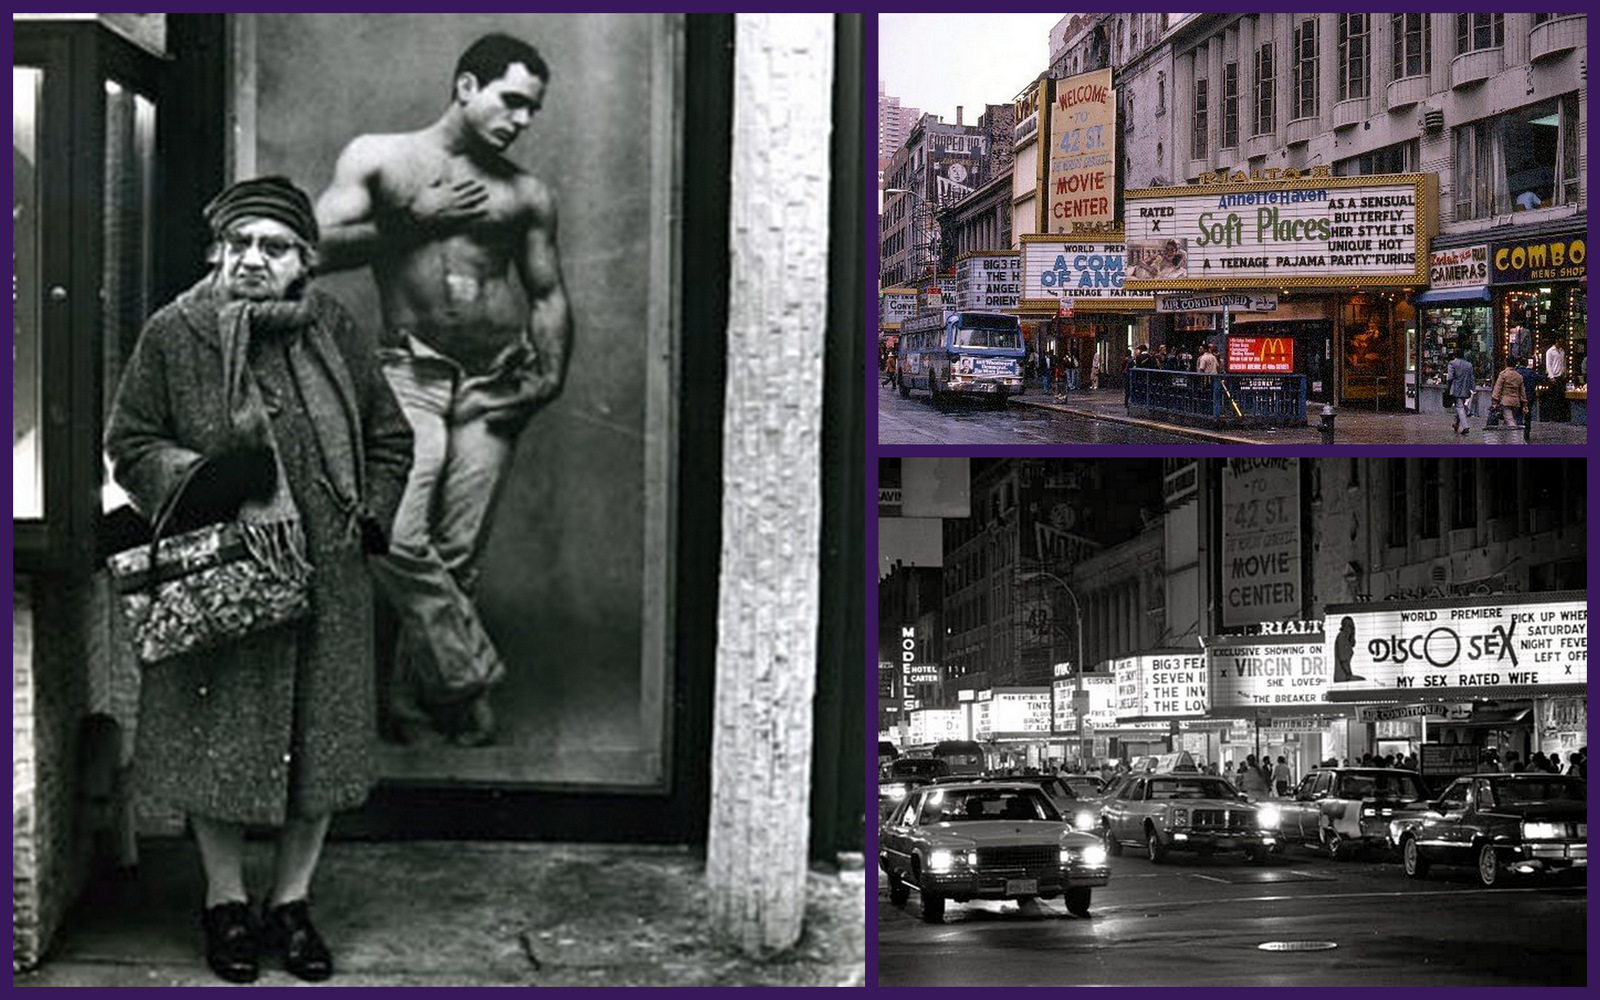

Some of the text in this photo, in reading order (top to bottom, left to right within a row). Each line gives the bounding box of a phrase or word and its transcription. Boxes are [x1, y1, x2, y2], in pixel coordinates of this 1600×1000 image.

[1059, 84, 1108, 111] WELCOME
[1074, 111, 1088, 124] TO
[1060, 129, 1080, 153] 42
[1199, 167, 1301, 184] RIALTO
[1056, 172, 1104, 195] MOVIE
[1053, 197, 1108, 218] CENTER
[1328, 195, 1415, 210] AS A SENSUAL
[1140, 207, 1174, 217] RATED
[1334, 210, 1405, 223] BUTTERFLY.
[1151, 220, 1161, 232] X
[1195, 207, 1332, 249] Soft Places
[1331, 225, 1415, 238] HER STYLE IS
[1064, 245, 1095, 253] WORLD
[1328, 239, 1403, 252] UNIQUE HOT
[1495, 239, 1586, 271] COMBO
[1053, 254, 1123, 271] A COM
[1203, 258, 1211, 269] A
[1220, 257, 1269, 269] TEENAGE
[1276, 255, 1325, 268] PAJAMA
[986, 272, 1006, 281] THE
[1431, 262, 1487, 282] CAMERAS
[1531, 266, 1585, 280] MENS SHOP
[1041, 271, 1071, 287] OF
[986, 284, 1020, 294] ANGEL
[1063, 289, 1103, 297] TEENAGE
[1163, 300, 1179, 310] AIR
[1181, 296, 1247, 310] CONDITIONED
[1234, 500, 1259, 528] 42
[1232, 553, 1289, 579] MOVIE
[1229, 582, 1295, 607] CENTER
[1401, 608, 1503, 622] WORLD PREMIERE
[1511, 613, 1535, 623] PICK
[1540, 612, 1555, 622] UP
[1260, 621, 1325, 635] RIALT
[1527, 623, 1586, 636] SATURDAY
[1467, 620, 1519, 667] SEX
[1521, 638, 1553, 649] NIGHT
[1213, 645, 1322, 657] EXCLUSIVE SHOWING ON
[1534, 652, 1561, 663] LEFT
[911, 666, 937, 674] HOTEL
[1152, 659, 1172, 670] BIG
[1173, 659, 1181, 669] 3
[1234, 657, 1292, 677] VIRGIN
[1565, 664, 1572, 675] X
[1152, 672, 1193, 684] SEVEN
[1266, 679, 1284, 687] SHE
[1397, 672, 1539, 688] MY SEX RATED WIFE
[1144, 691, 1149, 699] 2
[1154, 687, 1179, 699] THE
[1253, 694, 1271, 703] THE
[1275, 693, 1317, 703] BREAKER
[1154, 700, 1179, 712] THE
[1381, 705, 1445, 720] CONDITIONED
